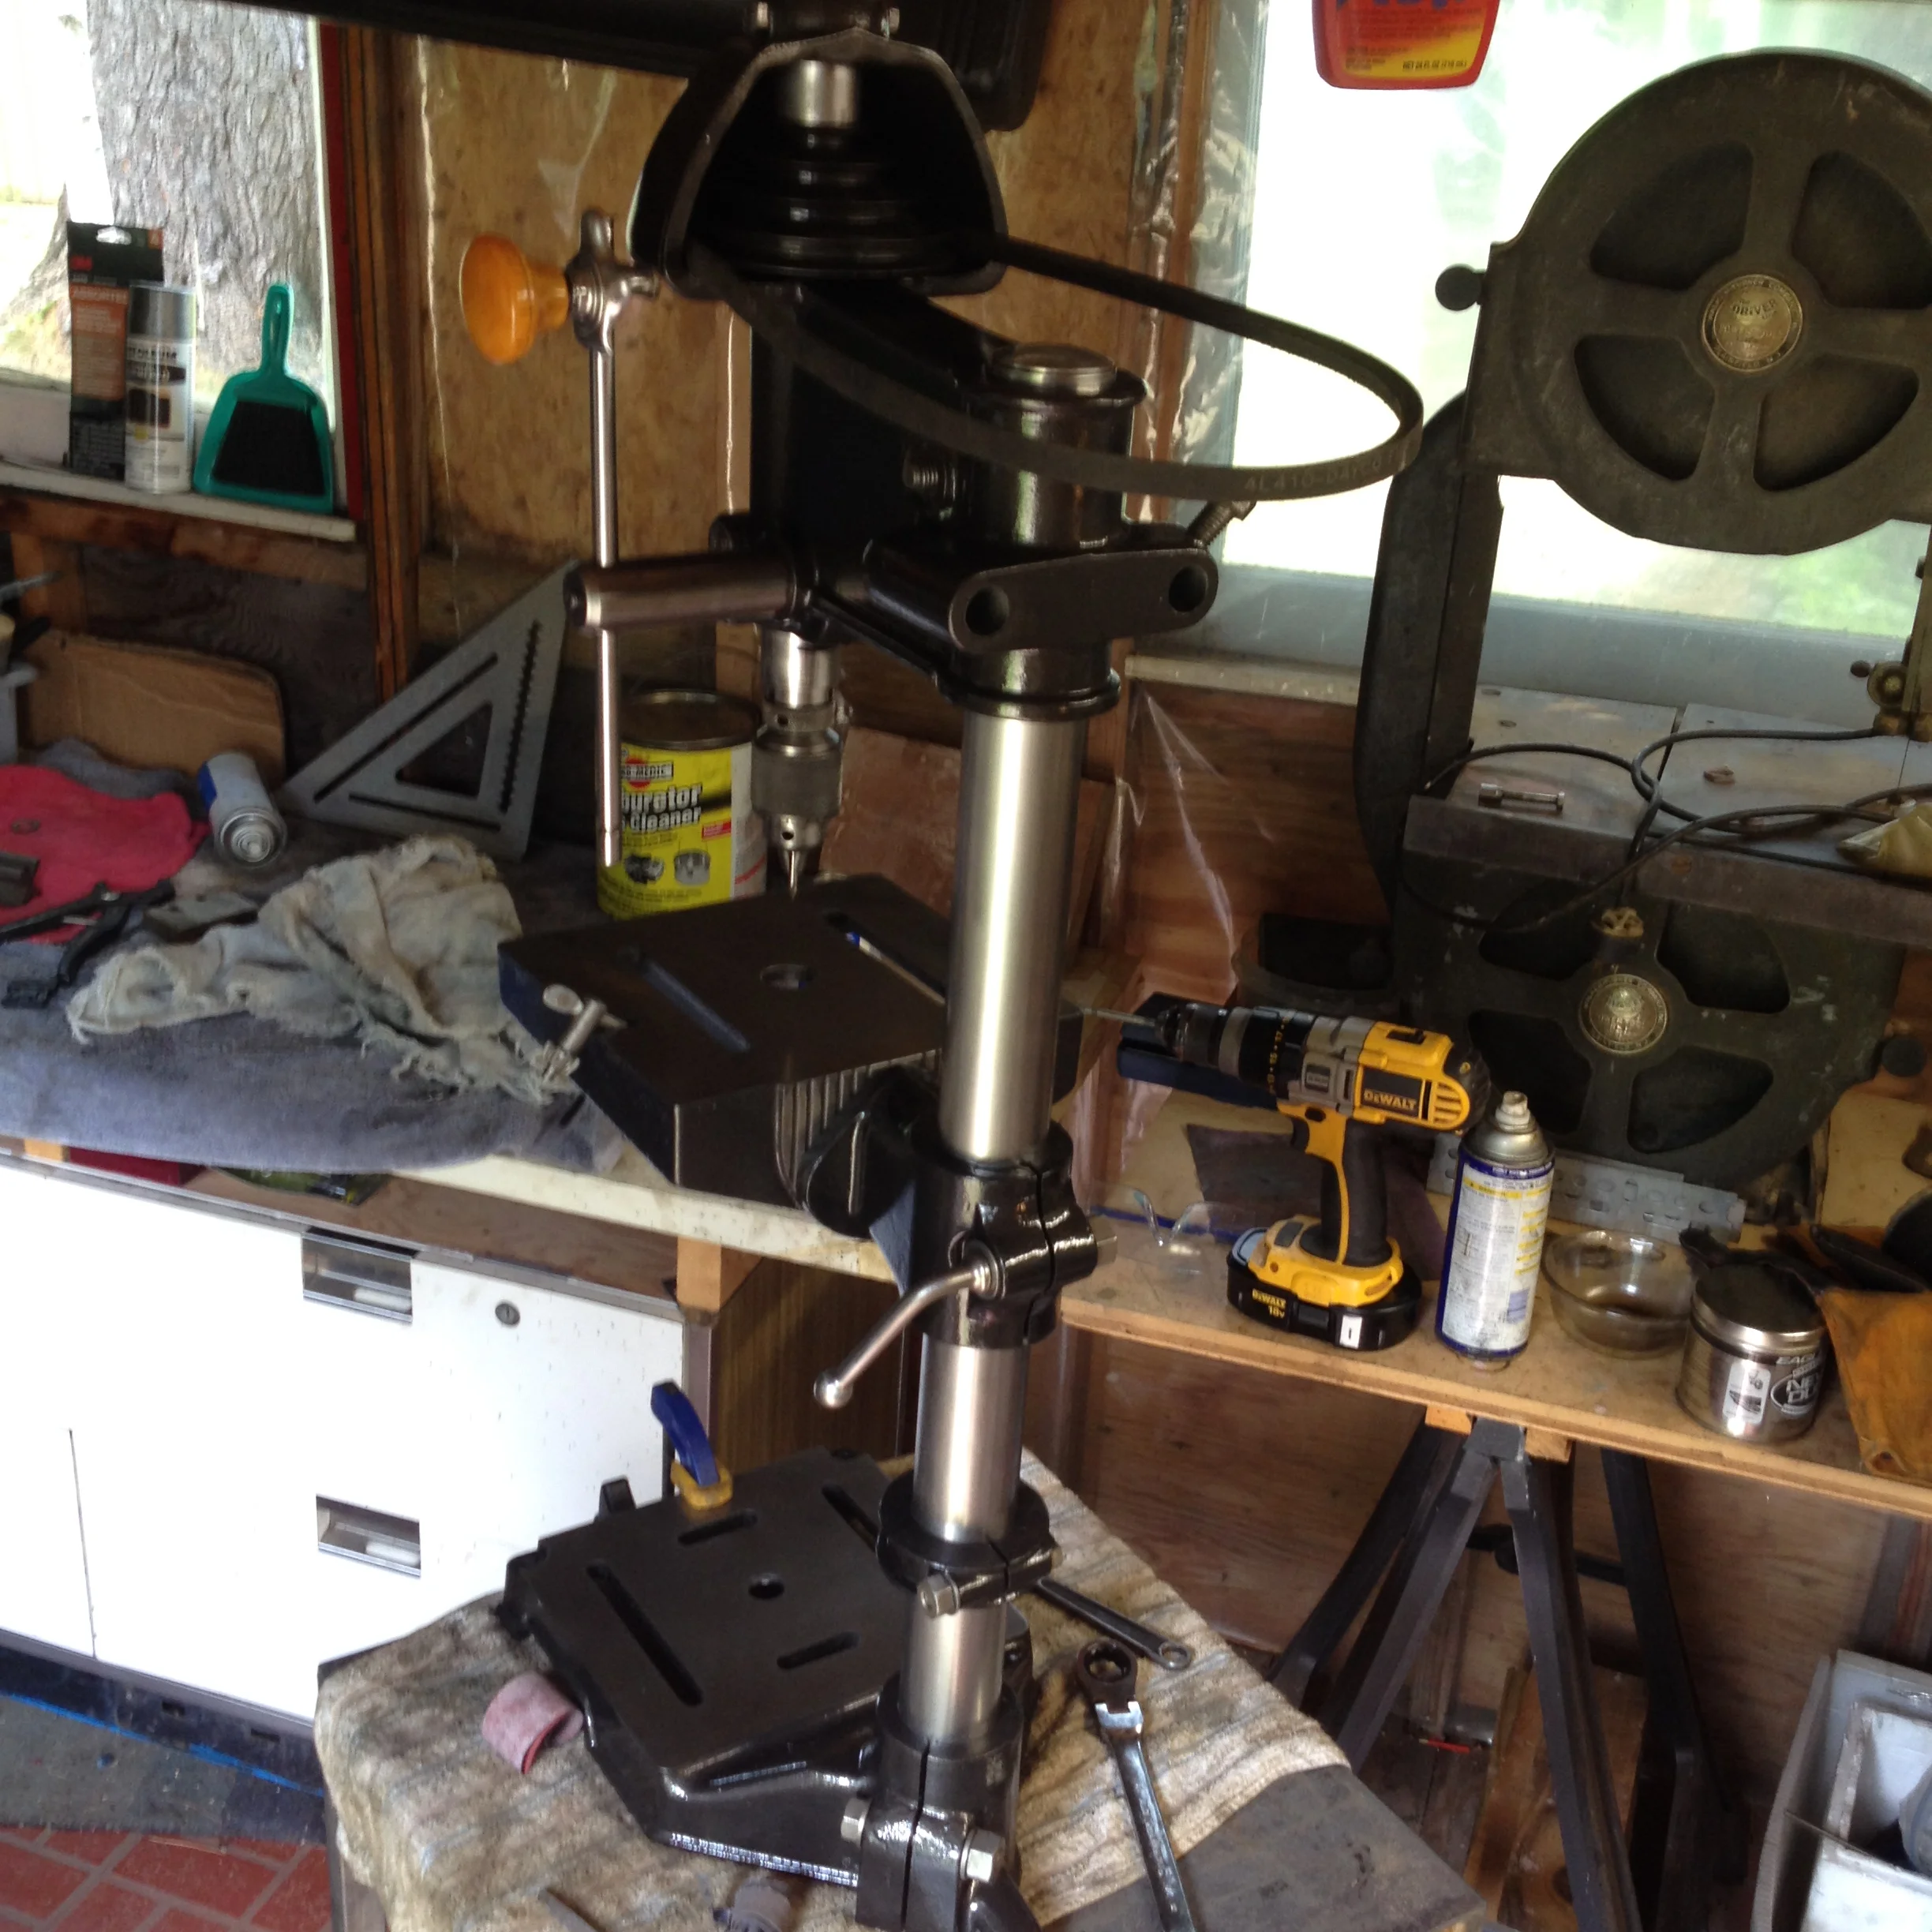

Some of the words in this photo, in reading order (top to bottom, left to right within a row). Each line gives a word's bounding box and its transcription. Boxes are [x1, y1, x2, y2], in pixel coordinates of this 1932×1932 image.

[1732, 298, 1777, 316] DRIVER
[1363, 1088, 1417, 1110] DEWALT
[1252, 1288, 1286, 1309] DEWALT
